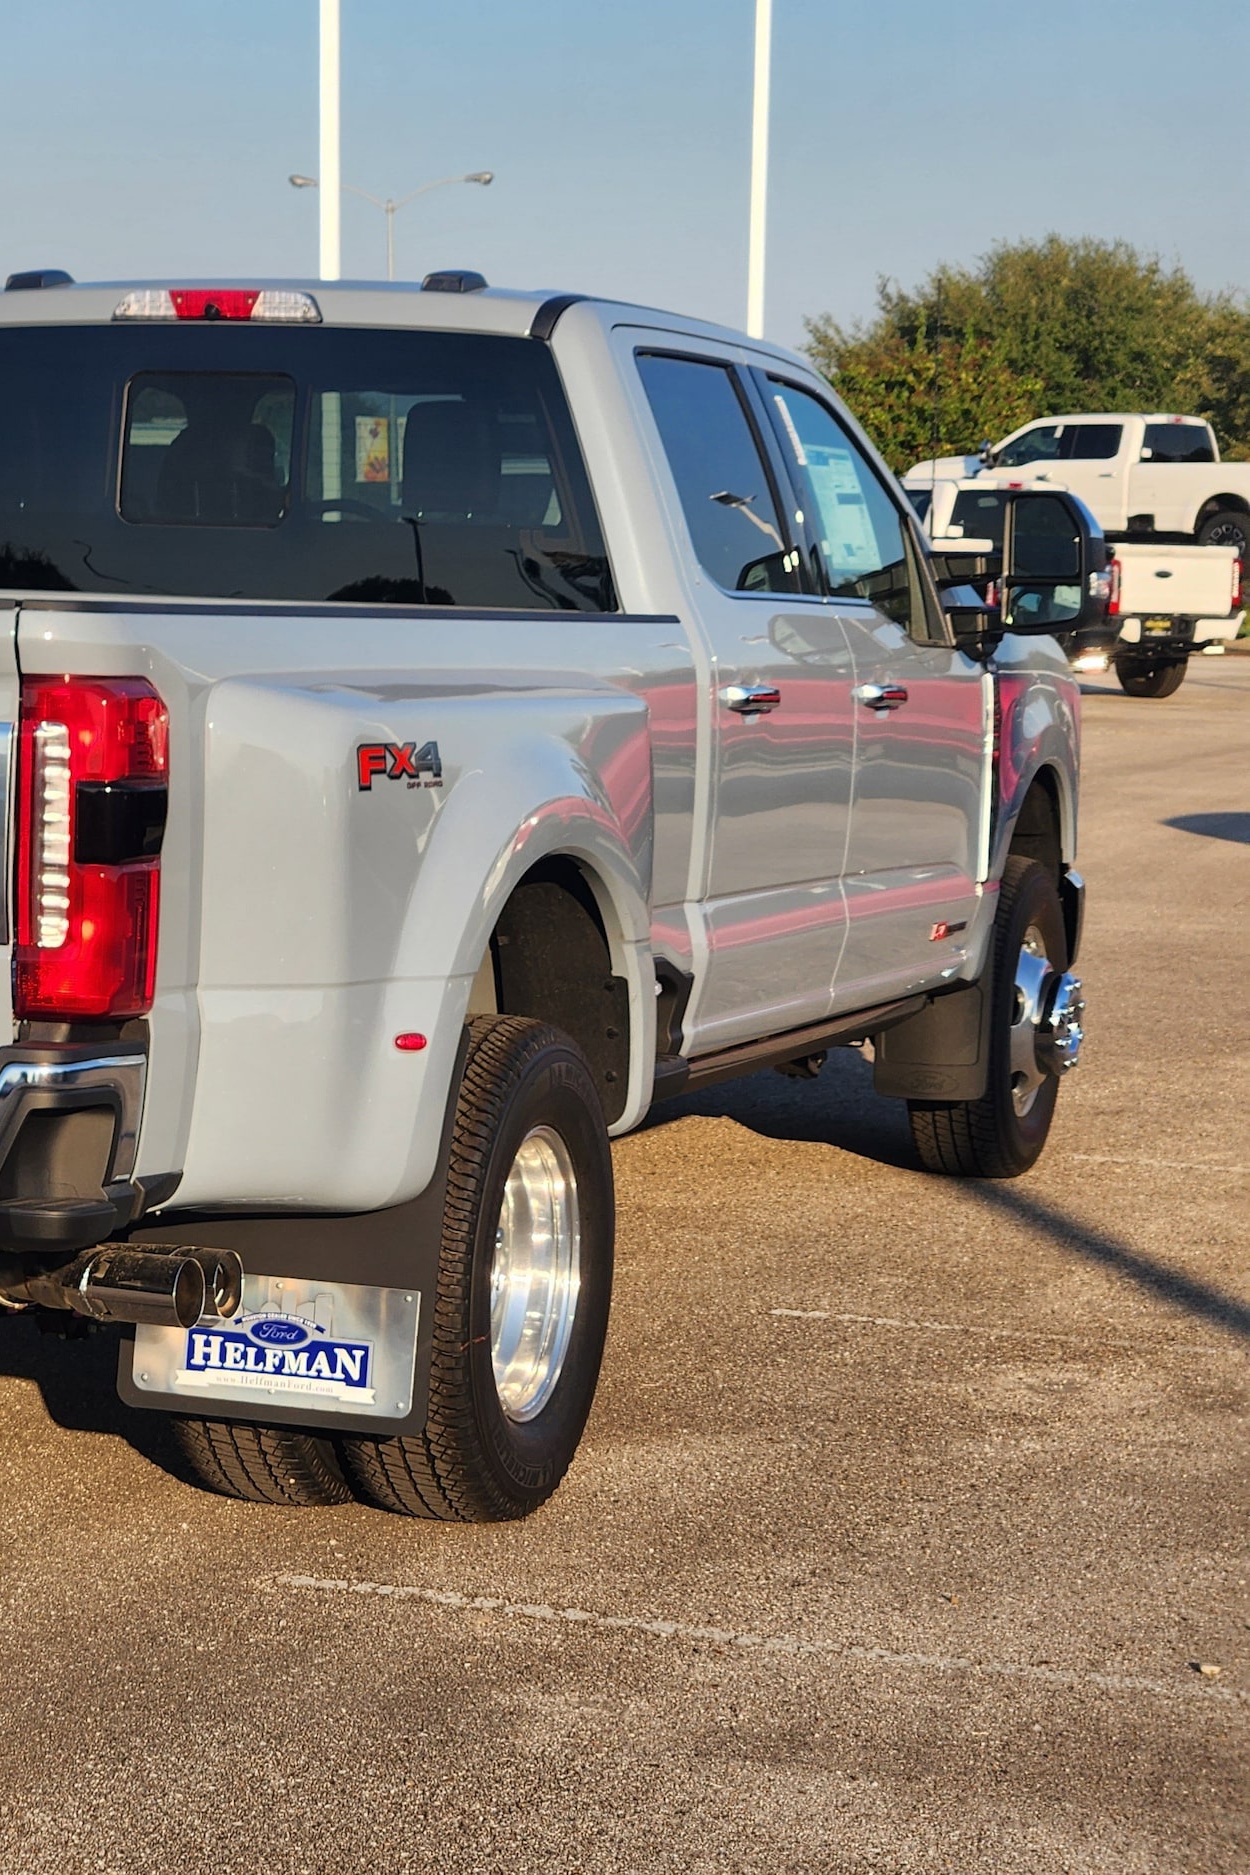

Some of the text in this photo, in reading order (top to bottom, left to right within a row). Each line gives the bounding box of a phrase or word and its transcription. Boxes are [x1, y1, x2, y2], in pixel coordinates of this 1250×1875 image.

[357, 741, 442, 792] FX4
[407, 781, 421, 789] OFF
[259, 1322, 299, 1340] Ford
[190, 1333, 366, 1382] HELFMAN
[216, 1375, 334, 1394] www.HelfmanFord.com
